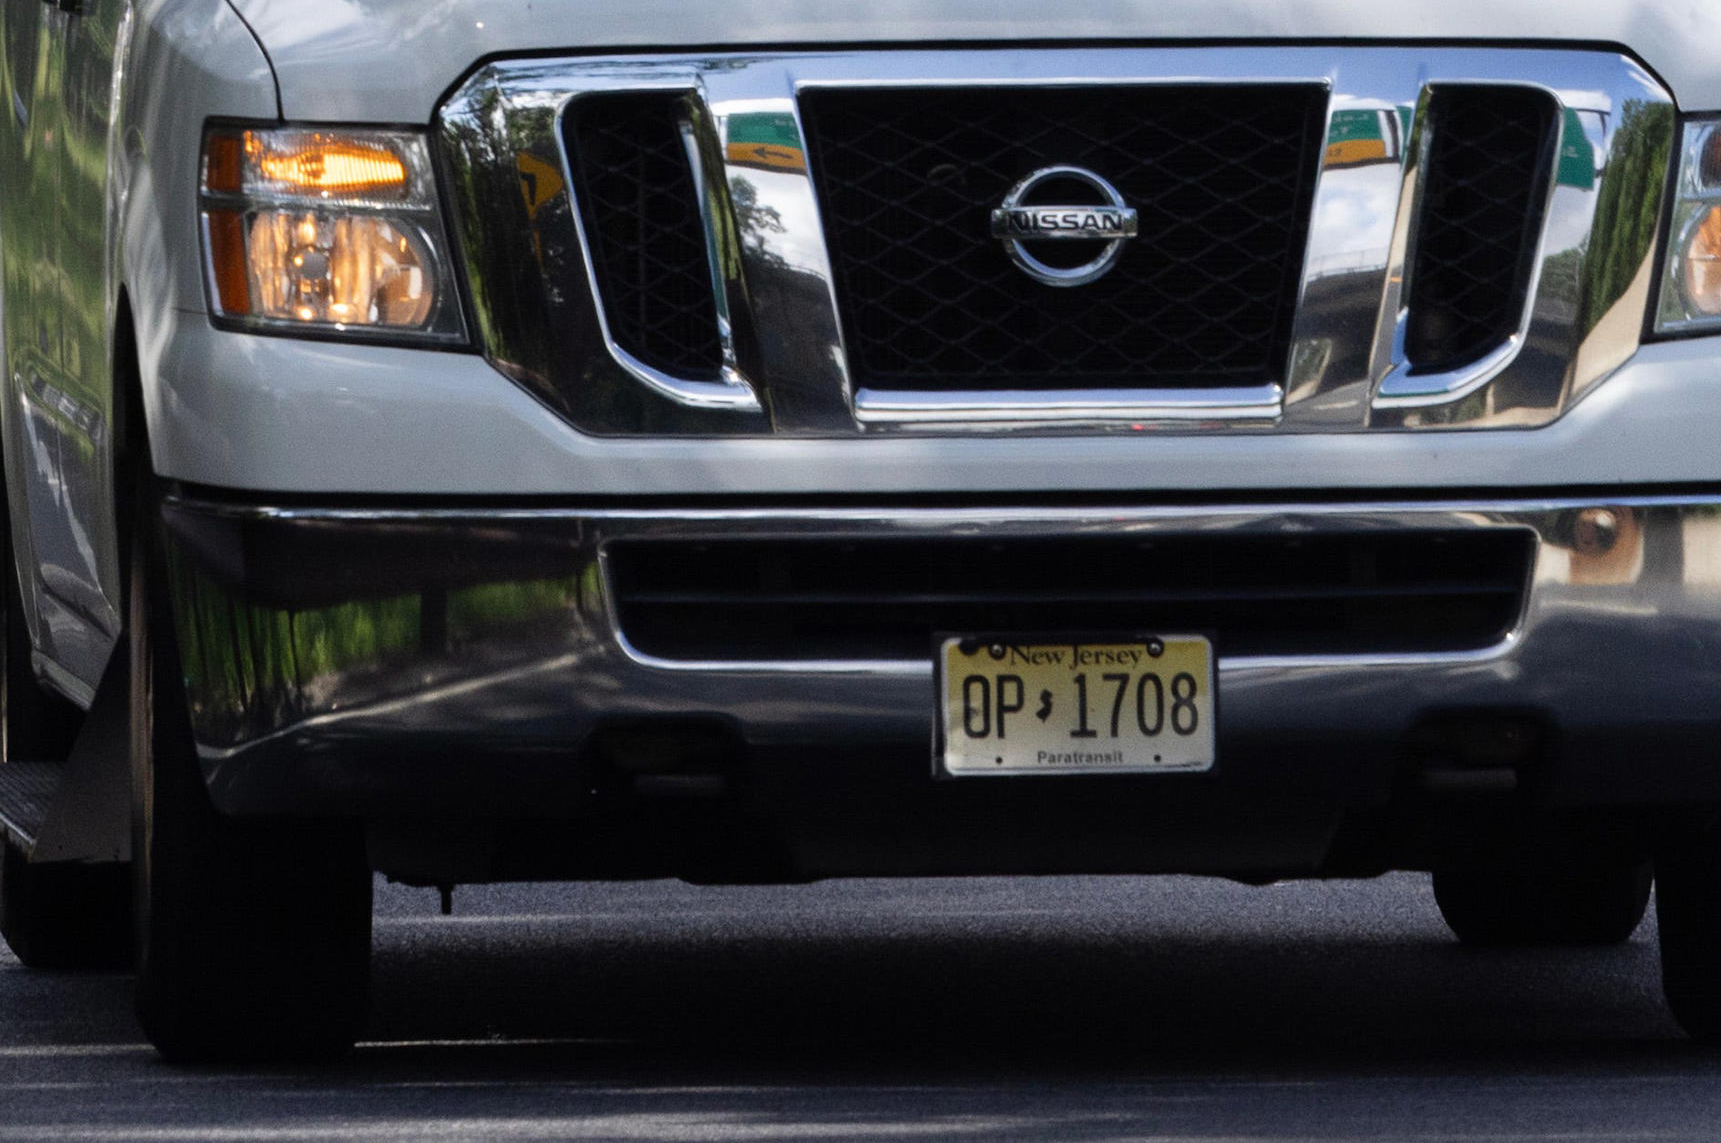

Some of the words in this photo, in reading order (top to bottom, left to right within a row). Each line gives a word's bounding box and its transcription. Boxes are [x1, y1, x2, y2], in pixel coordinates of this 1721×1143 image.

[1006, 213, 1123, 232] NISSAN
[1010, 645, 1065, 666] New
[1069, 645, 1143, 670] Jersey
[1069, 672, 1199, 738] 1708
[1037, 750, 1123, 764] Paratransit
